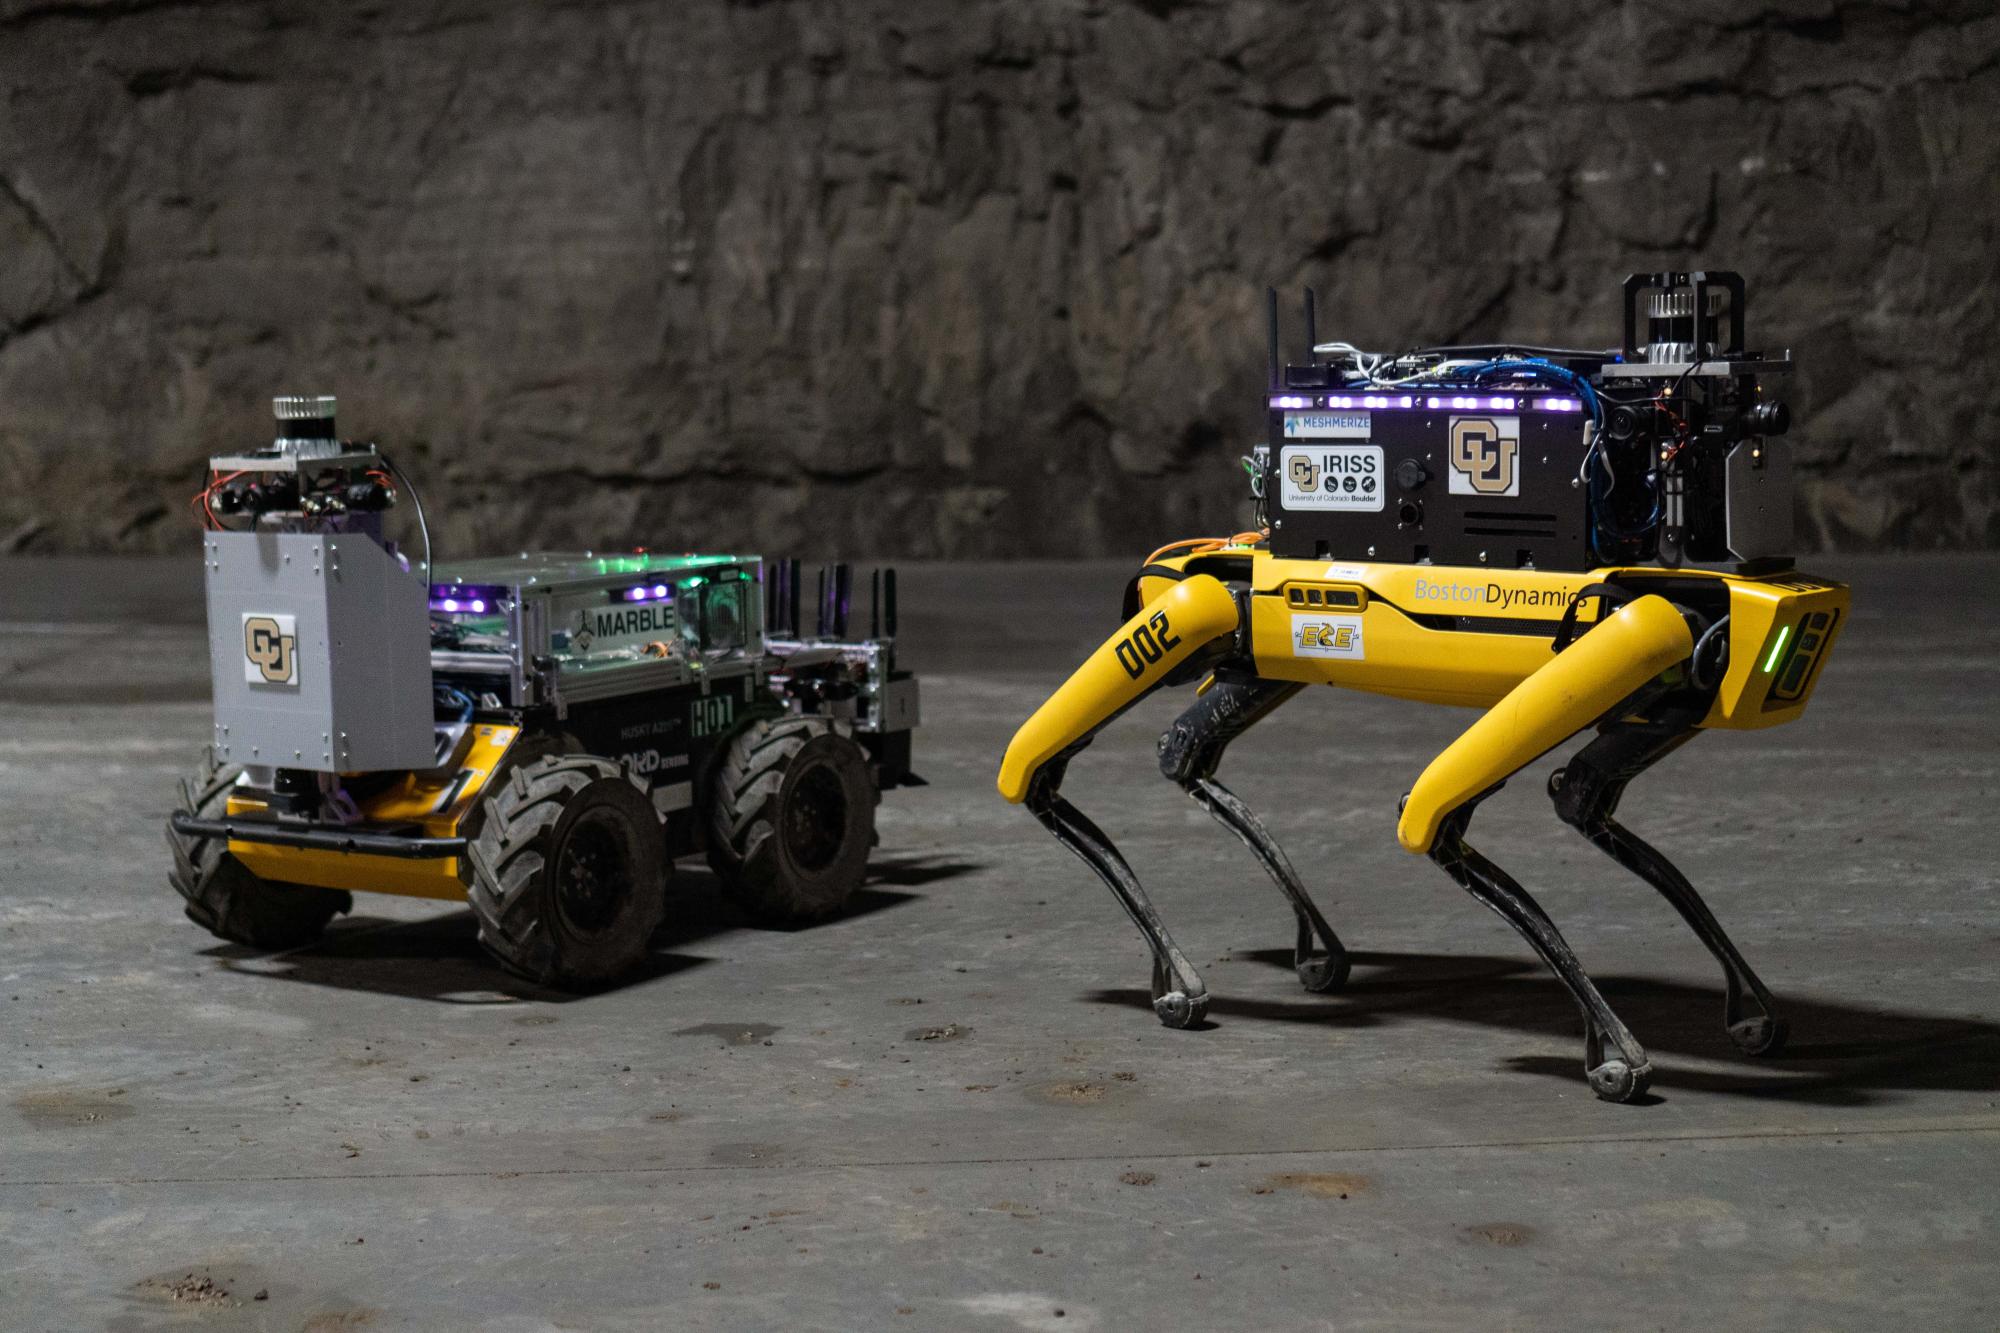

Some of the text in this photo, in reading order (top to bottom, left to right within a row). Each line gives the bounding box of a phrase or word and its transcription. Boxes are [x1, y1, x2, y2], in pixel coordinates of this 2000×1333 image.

[1303, 415, 1370, 428] MESHMERIZE
[1323, 455, 1376, 473] IRISS
[597, 606, 674, 637] MARBLE
[1115, 610, 1181, 680] 002
